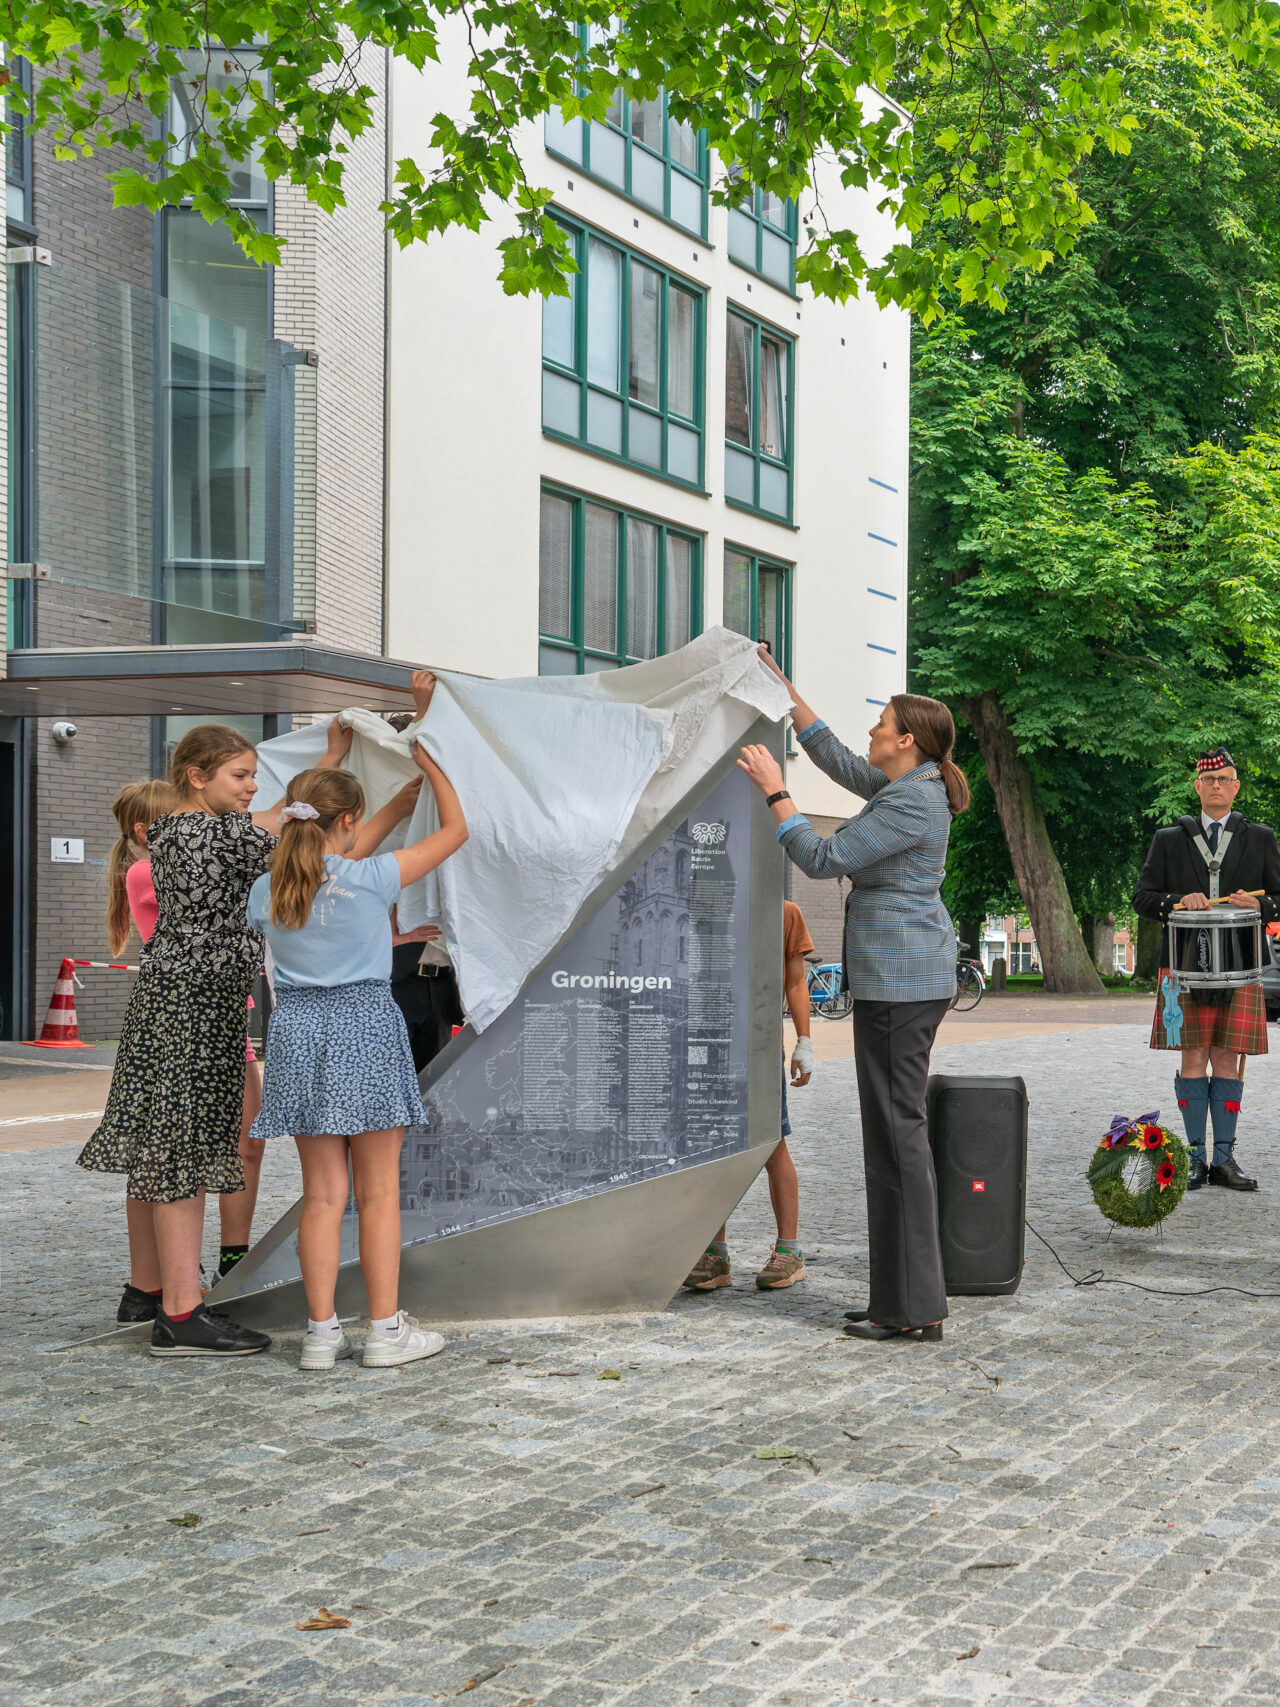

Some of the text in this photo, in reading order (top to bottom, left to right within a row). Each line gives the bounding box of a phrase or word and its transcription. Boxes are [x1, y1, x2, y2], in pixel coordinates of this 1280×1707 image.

[63, 840, 70, 855] 1
[320, 874, 357, 899] Team
[551, 970, 673, 994] Groningen
[609, 1172, 629, 1183] 1945
[441, 1224, 461, 1236] 1944
